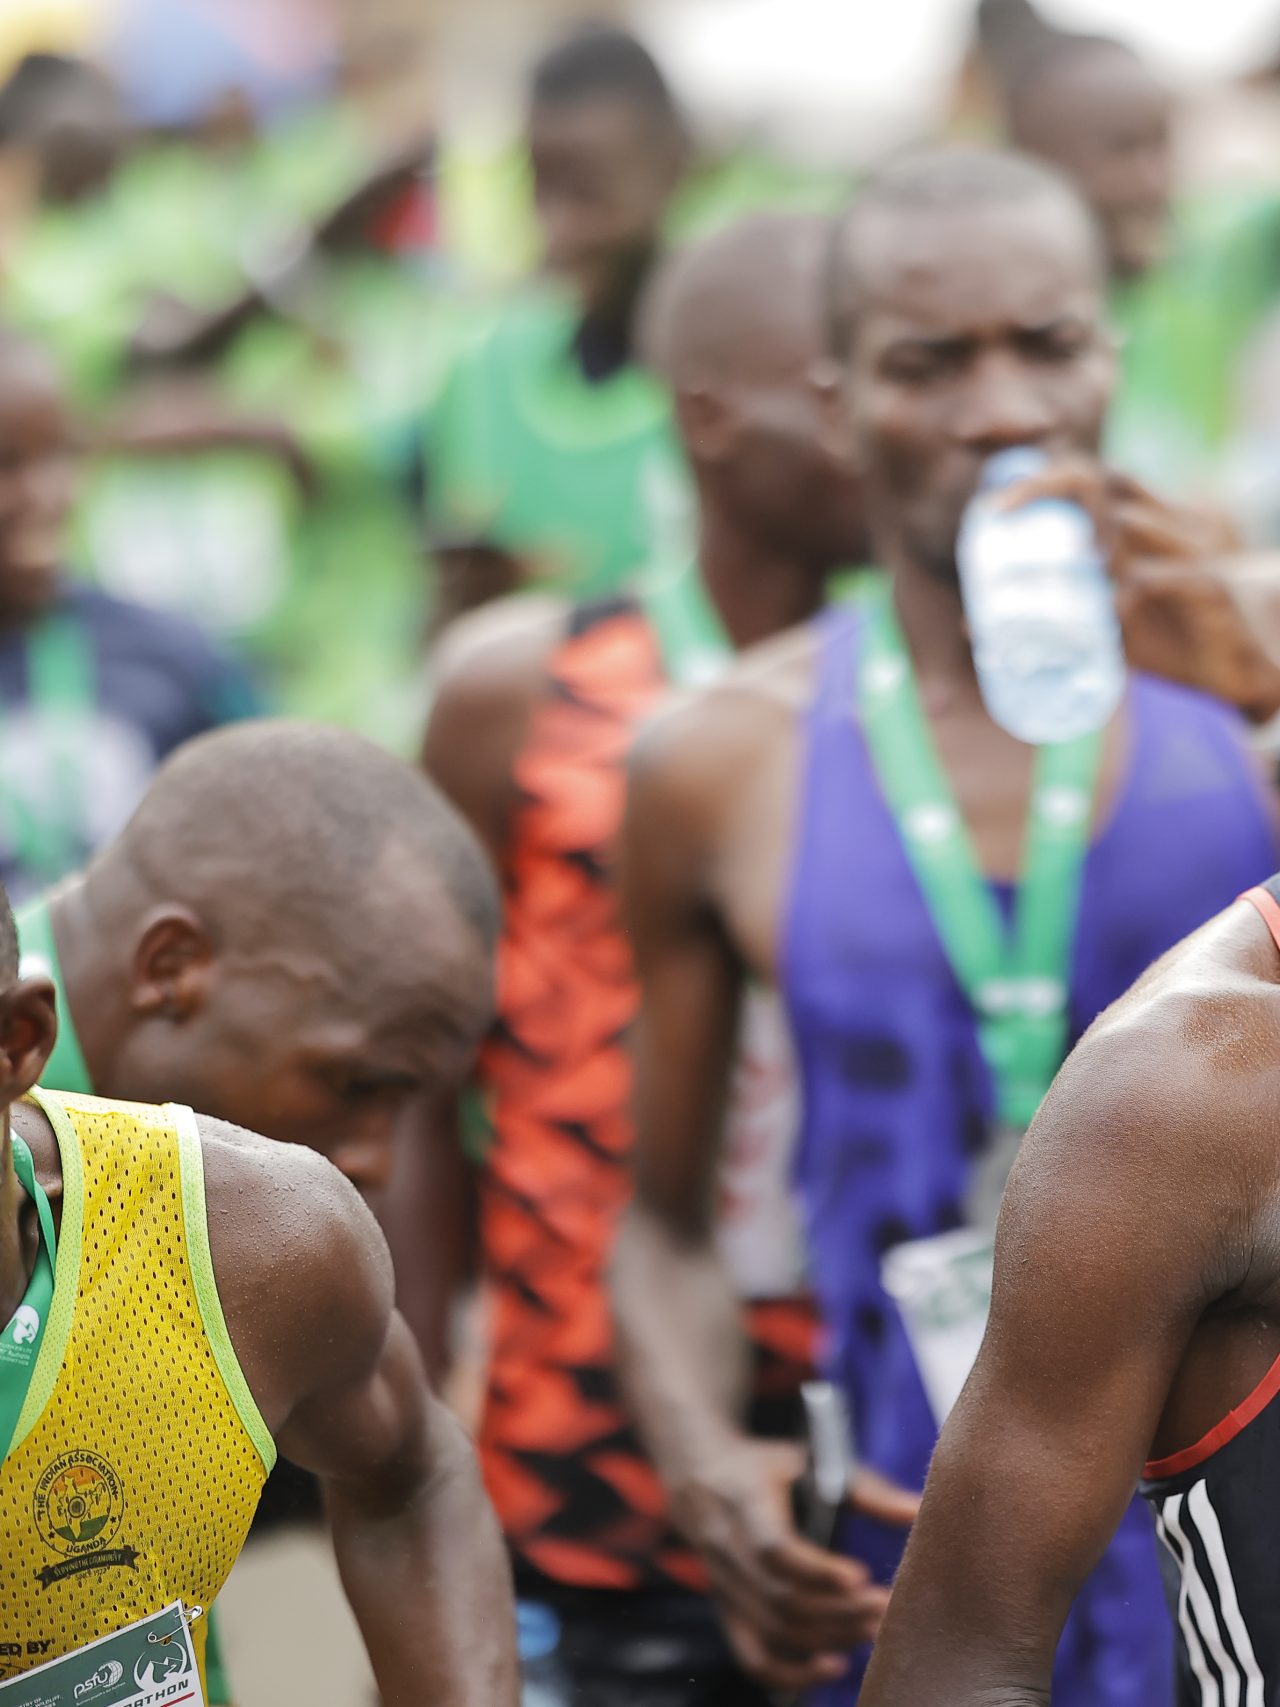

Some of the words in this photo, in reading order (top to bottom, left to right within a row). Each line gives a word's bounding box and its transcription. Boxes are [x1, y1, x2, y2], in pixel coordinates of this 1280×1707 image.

[40, 1459, 67, 1491] INDIAN
[68, 1453, 119, 1497] ASSOCIATION
[36, 1494, 47, 1515] THE
[66, 1537, 107, 1553] UGANDA
[27, 1640, 51, 1654] BY
